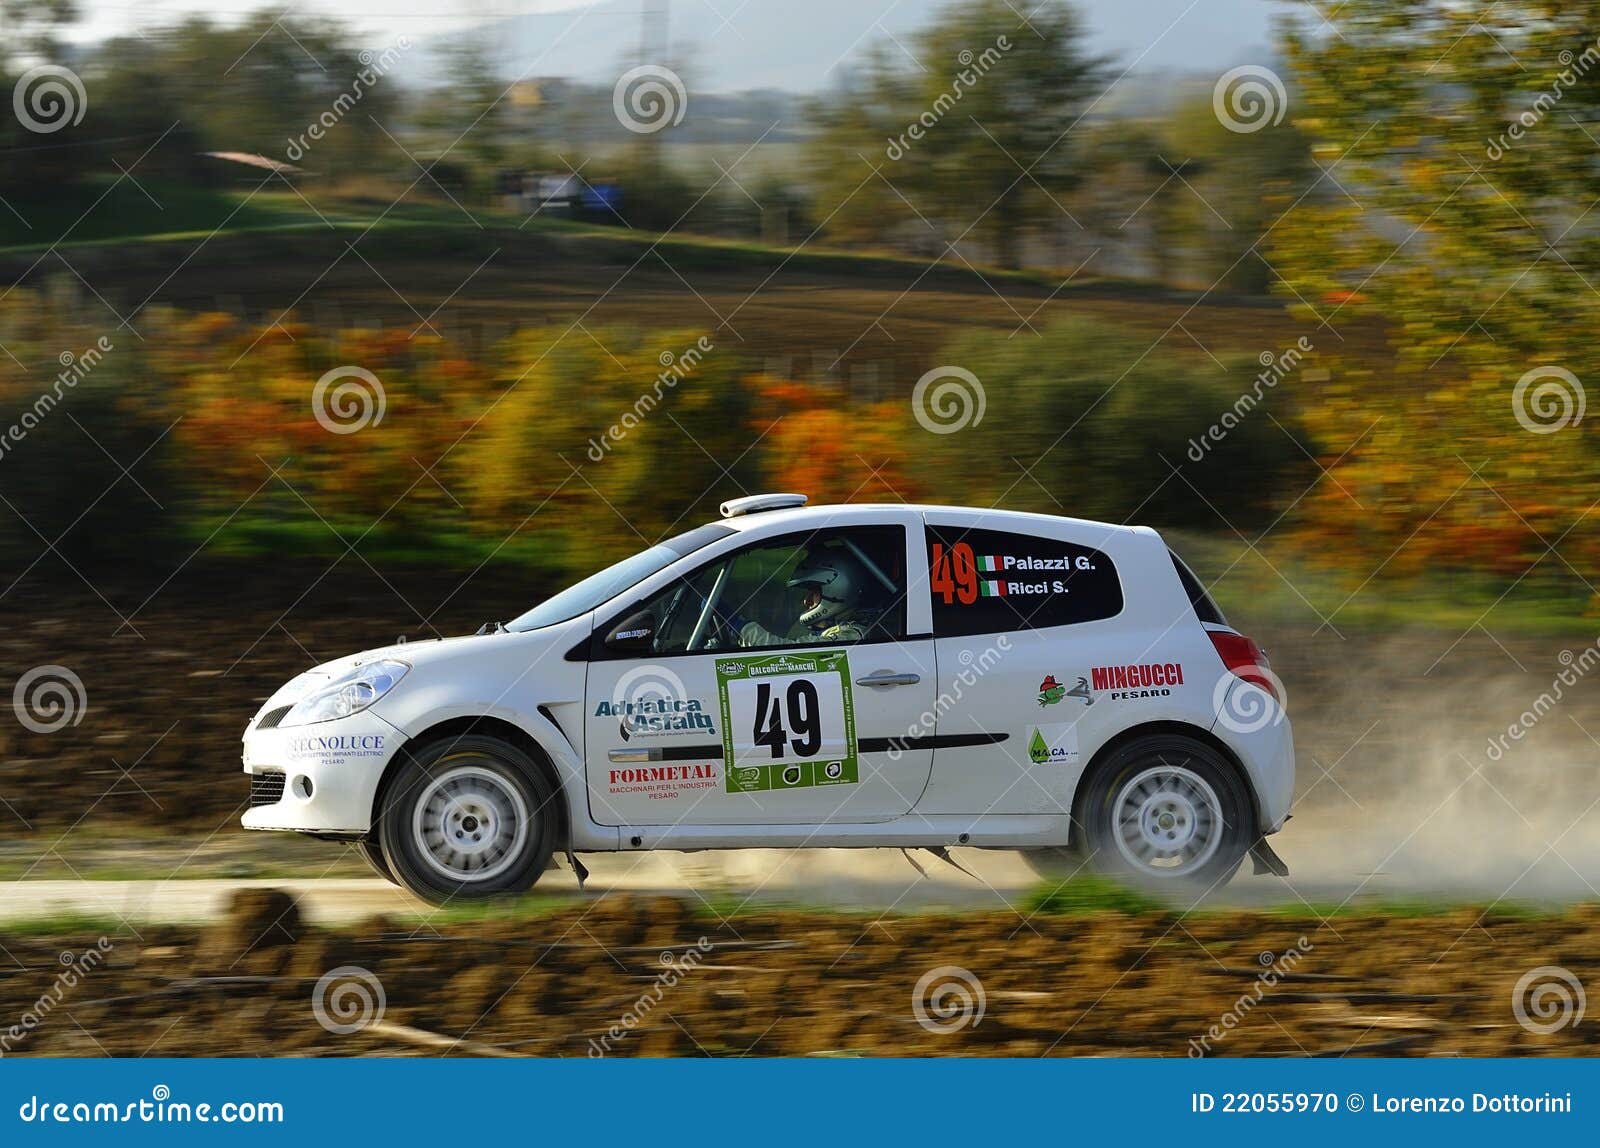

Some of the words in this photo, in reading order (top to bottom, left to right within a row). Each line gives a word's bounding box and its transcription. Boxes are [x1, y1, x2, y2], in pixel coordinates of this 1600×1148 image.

[1003, 556, 1070, 570] Palazzi
[1075, 556, 1096, 570] G.
[931, 542, 978, 605] 49
[1007, 582, 1049, 595] Ricci
[1052, 581, 1069, 593] S.
[1091, 663, 1184, 691] MINGUCCI
[1111, 689, 1171, 700] PESARO
[595, 696, 702, 717] Adriatica
[753, 679, 822, 758] 49
[292, 735, 385, 751] TECNOLUCE
[609, 764, 717, 784] FORMETAL
[609, 785, 655, 794] MACCHINARI
[648, 791, 679, 799] PESARO
